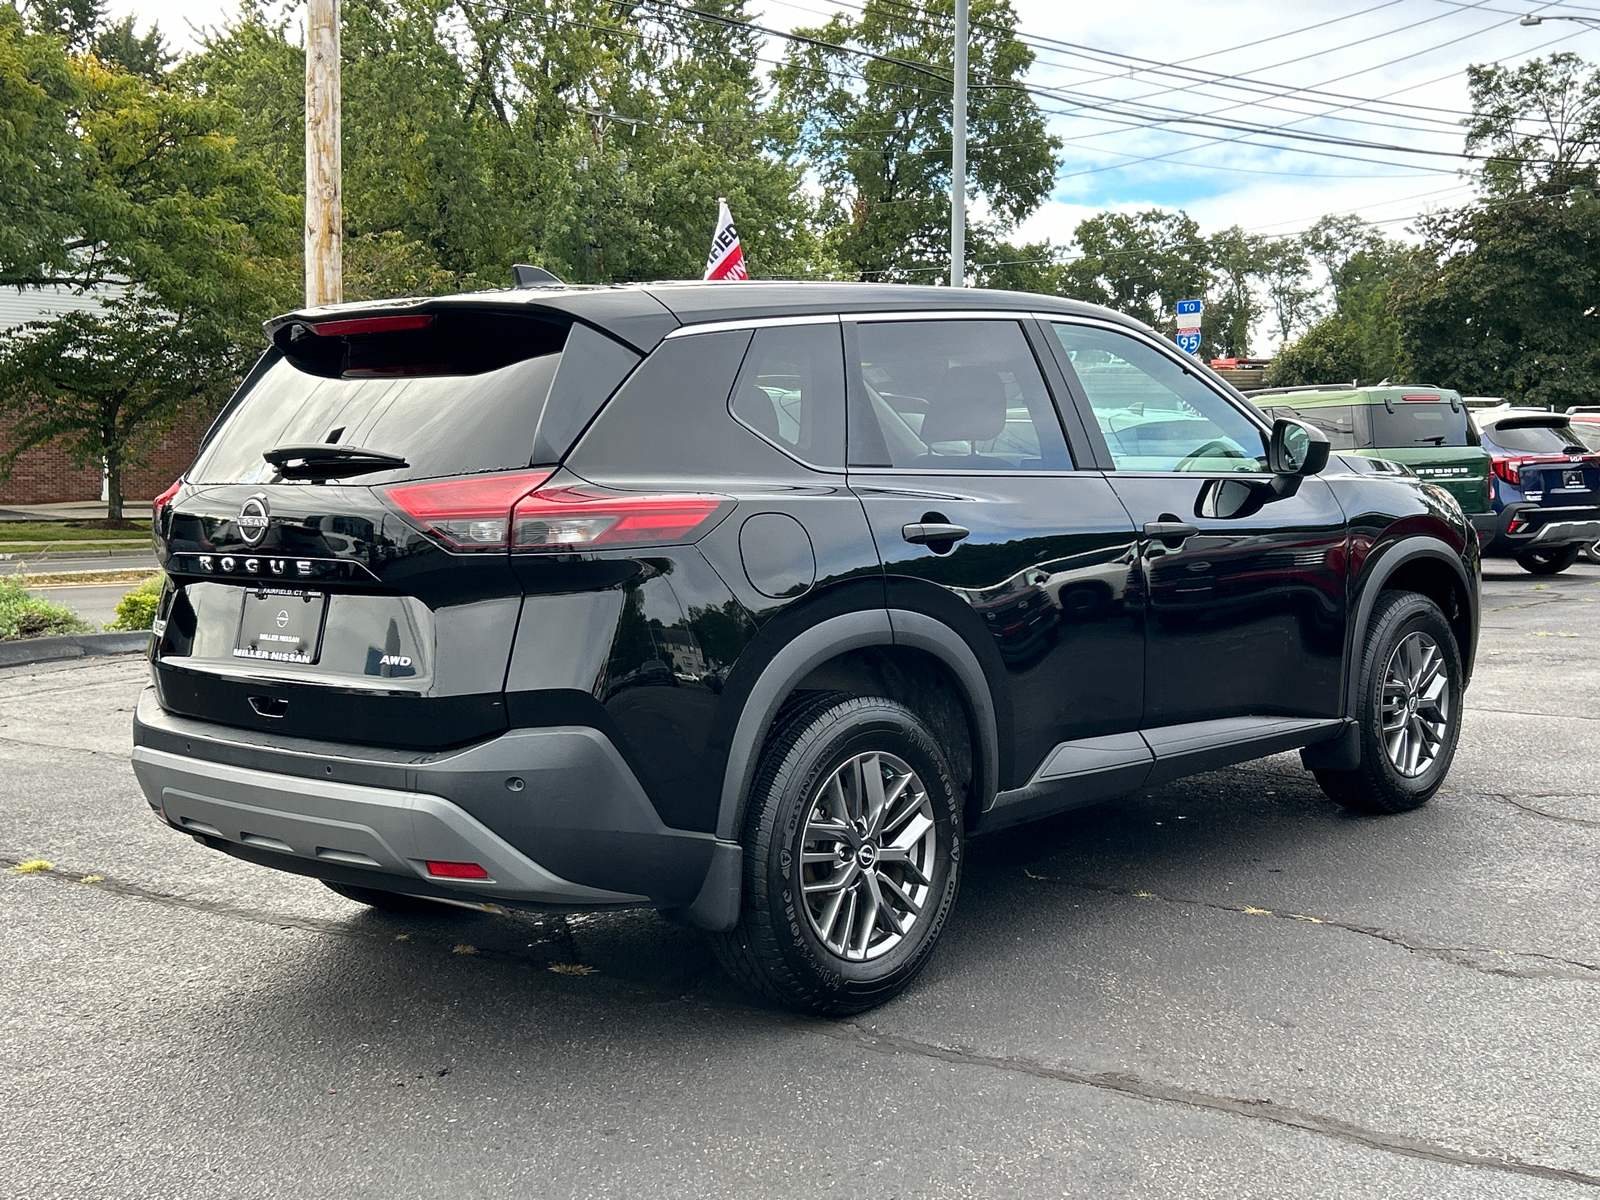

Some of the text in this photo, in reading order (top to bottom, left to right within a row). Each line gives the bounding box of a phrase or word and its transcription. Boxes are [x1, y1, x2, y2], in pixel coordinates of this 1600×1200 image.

[1183, 303, 1196, 312] TO
[1180, 336, 1198, 350] 95
[237, 517, 268, 526] NISSAN
[199, 555, 313, 575] ROGUE
[259, 633, 300, 643] MILLER NISSAN
[233, 648, 311, 664] MILLER NISSAN
[379, 654, 412, 667] AWD
[789, 747, 832, 830] DESTINATION
